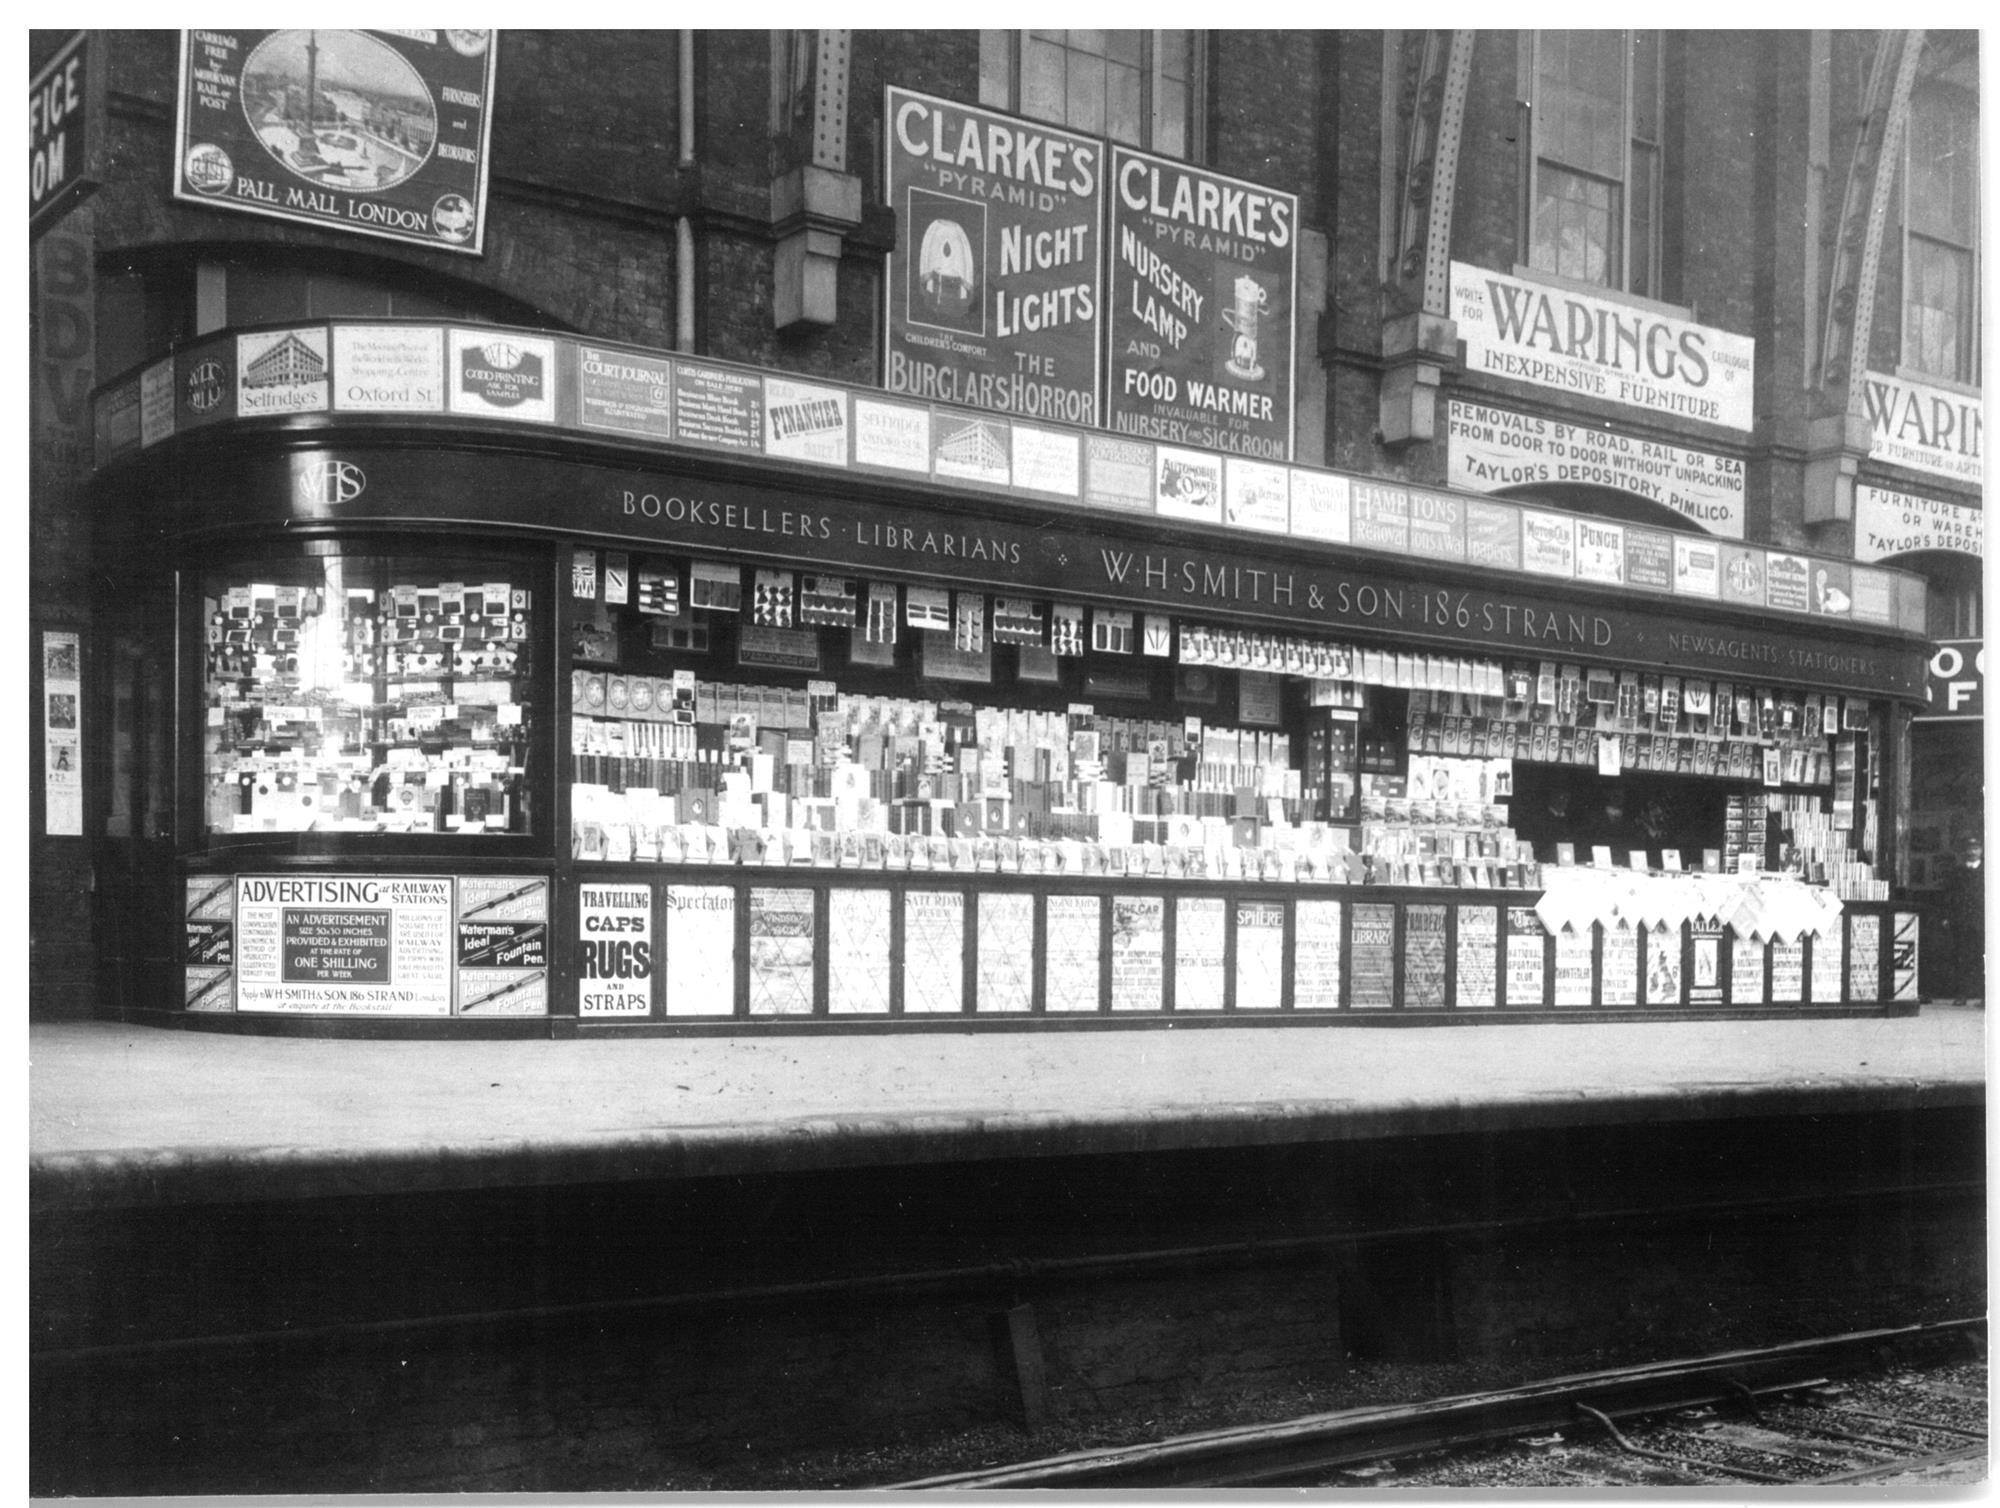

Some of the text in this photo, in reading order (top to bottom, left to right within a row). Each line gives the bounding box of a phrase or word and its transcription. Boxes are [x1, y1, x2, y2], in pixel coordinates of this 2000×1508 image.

[896, 101, 1094, 197] CLARKE'S
[236, 176, 428, 231] PALL MALL LONDON
[1120, 159, 1290, 247] CLARKE'S
[1000, 224, 1088, 276] NIGHT
[1122, 224, 1204, 324] NURSERY
[997, 284, 1094, 337] LIGHTS
[1133, 280, 1187, 350] LAMP
[1462, 305, 1483, 321] FOR
[1485, 280, 1709, 387] WARINGS
[1127, 340, 1161, 359] AND
[584, 361, 667, 385] COURT JOURNAL
[1014, 351, 1055, 377] THE
[465, 369, 539, 386] GOOD PRINTING
[891, 351, 1093, 424] BURGLAR'S HORROR
[1484, 350, 1720, 420] INEXPENSIVE FURNITURE
[348, 385, 410, 402] Oxford
[1125, 368, 1273, 422] FOOD WARMER
[769, 399, 843, 440] FINANCIER
[1117, 411, 1190, 443] NURSERY
[1154, 404, 1250, 431] INVALUABLE FOR
[1451, 402, 1545, 434] REMOVALS
[1555, 425, 1576, 441] BY
[1642, 442, 1678, 463] RAIL
[1686, 453, 1705, 468] OR
[1715, 457, 1742, 475] SEA
[1450, 421, 1743, 492] FROM DOOR TO DOOR WITHOUT UNPACKING
[1888, 442, 1943, 467] FURNITURE
[1465, 454, 1549, 483] TAYLOR'S
[1181, 475, 1218, 495] OWNER
[1355, 486, 1457, 523] HAMPTONS
[1870, 489, 1960, 519] FURNITURE
[1903, 513, 1921, 526] OR
[1580, 524, 1618, 549] PUNCH
[1868, 533, 1931, 551] TAYLOR'S
[623, 491, 830, 539] BOOKSELLERS
[856, 522, 1020, 564] LIBRARIANS
[1308, 584, 1325, 610] &
[1338, 583, 1403, 618] SON
[1423, 590, 1470, 628] 186
[1483, 602, 1612, 646] STRAND
[1669, 632, 1777, 664] NEWSAGENTS
[1789, 649, 1875, 676] STATIONERS
[241, 881, 379, 903] ADVERTISING
[392, 883, 447, 895] RAILWAY
[392, 894, 448, 905] STATIONS
[582, 890, 649, 909] TRAVELLING
[667, 890, 734, 912] Spectator
[905, 894, 964, 907] SATURDAY
[286, 914, 388, 926] AN ADVERTISEMENT
[1115, 903, 1160, 915] THE CAR
[1236, 910, 1282, 926] SPHERE
[298, 927, 313, 936] SIZE
[343, 928, 373, 936] INCHES
[586, 915, 645, 933] CAPS
[286, 937, 387, 947] PROVIDED & EXHIBITED
[464, 935, 490, 951] Ideal
[1351, 930, 1392, 945] LIBRARY
[295, 957, 377, 969] ONE SHILLING
[497, 939, 542, 965] Fountain
[579, 940, 651, 979] RUGS
[332, 970, 352, 978] WEEK
[324, 989, 347, 1000] SON
[350, 990, 364, 1000] 186
[367, 990, 414, 1001] STRAND
[606, 983, 625, 991] AND
[584, 993, 647, 1011] STRAPS
